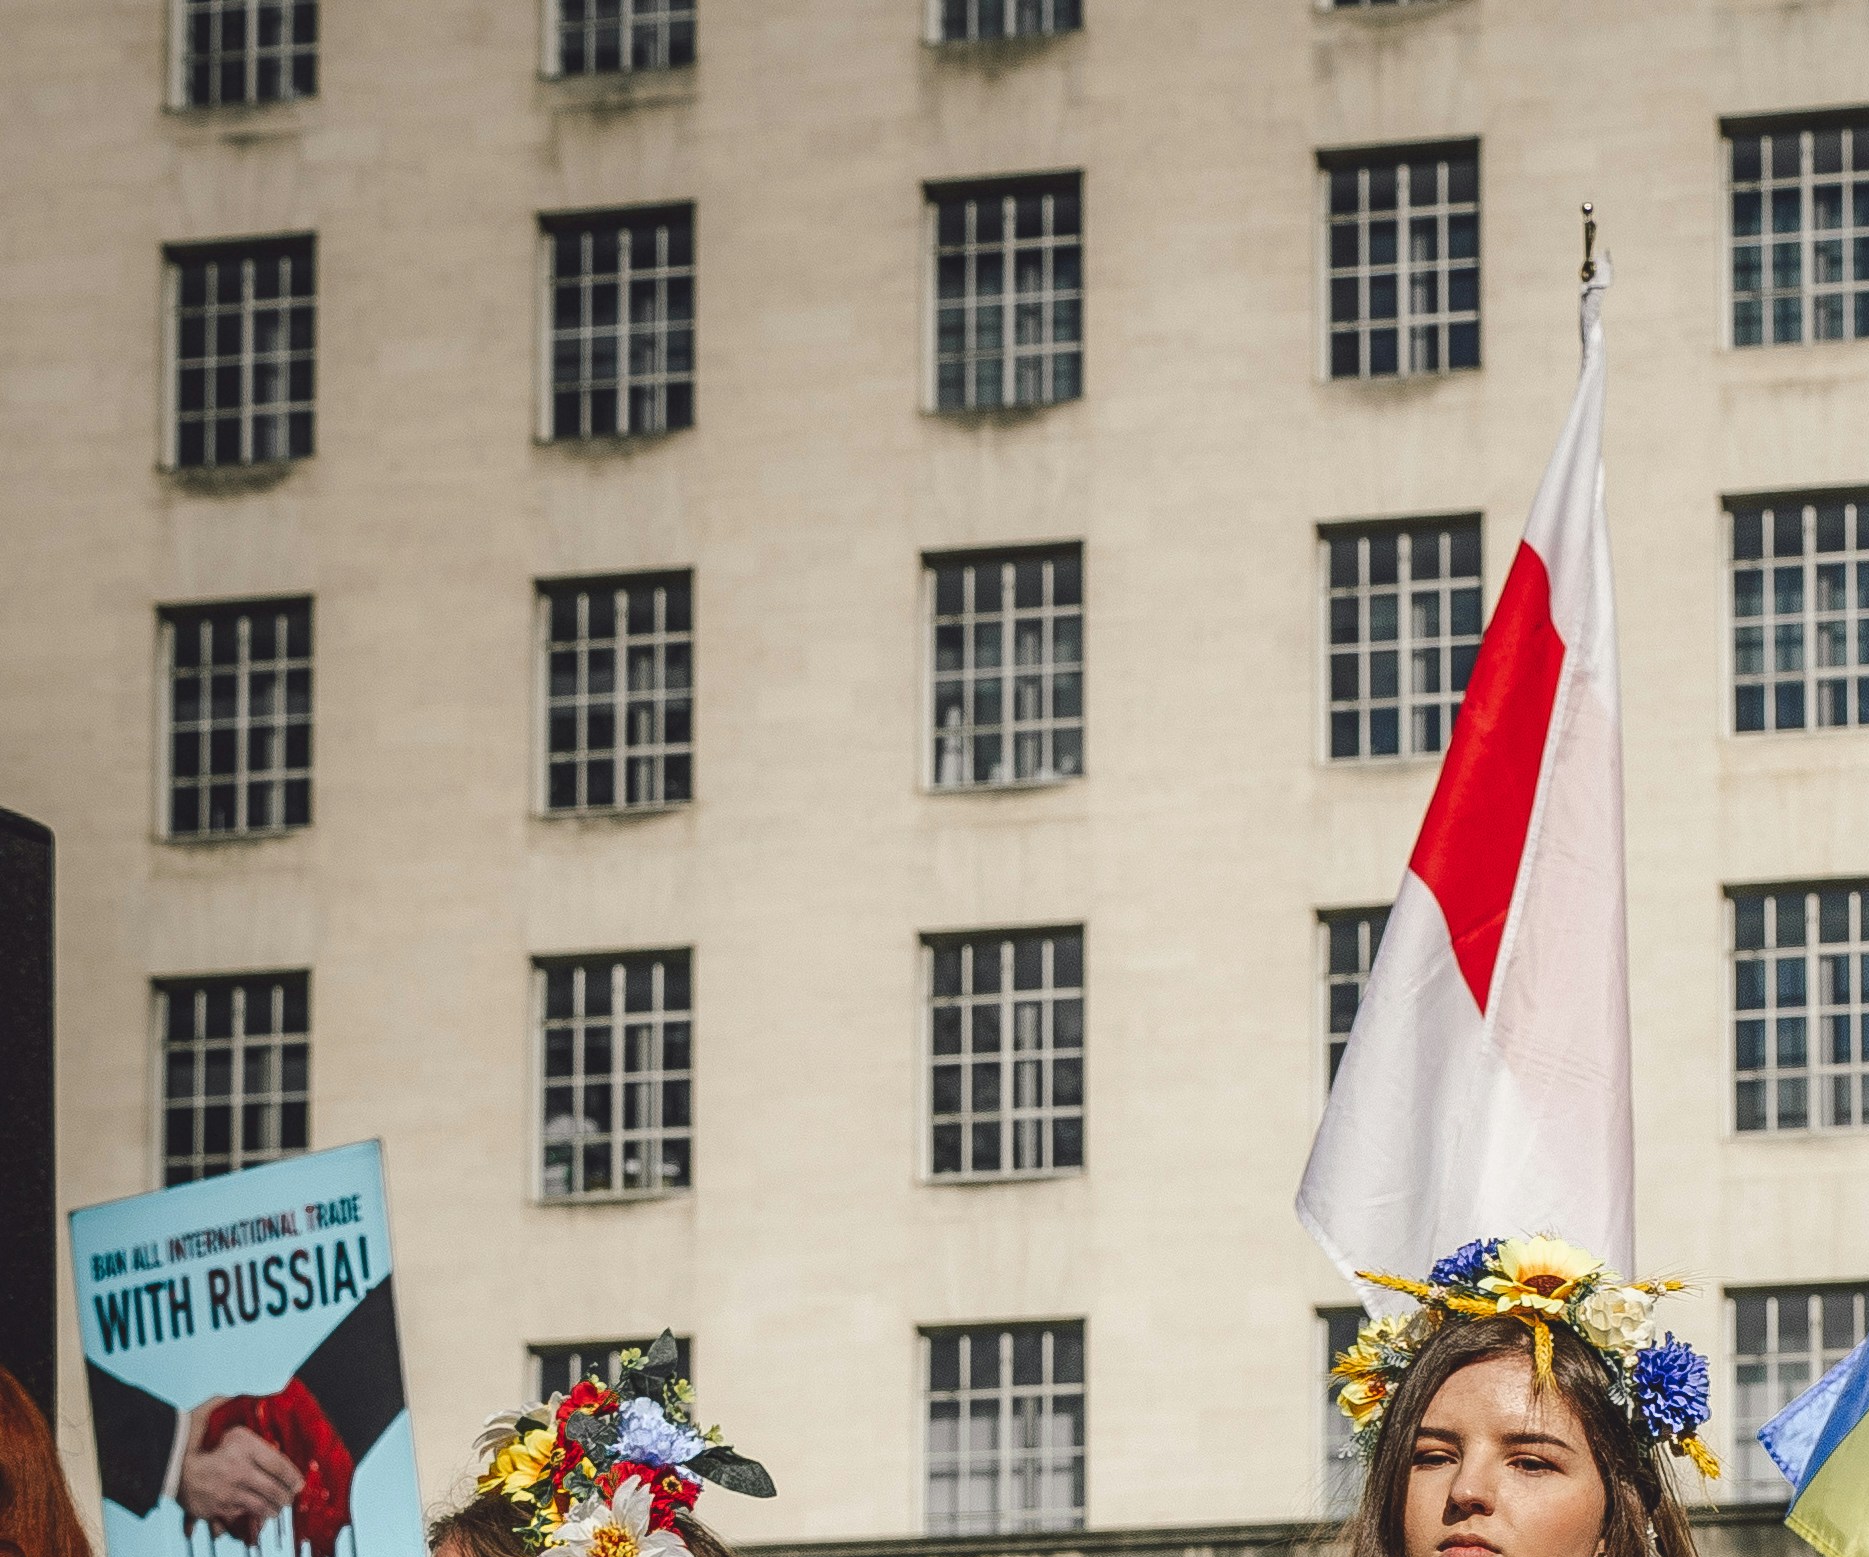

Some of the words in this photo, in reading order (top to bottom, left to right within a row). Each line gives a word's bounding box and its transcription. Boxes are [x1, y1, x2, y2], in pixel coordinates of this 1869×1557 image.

[91, 1249, 127, 1281] BAN
[132, 1242, 163, 1272] ALL
[167, 1210, 300, 1264] INTERNATIONAL
[304, 1193, 362, 1231] TRADE
[94, 1276, 195, 1355] WITH
[208, 1235, 373, 1329] RUSSIA!
